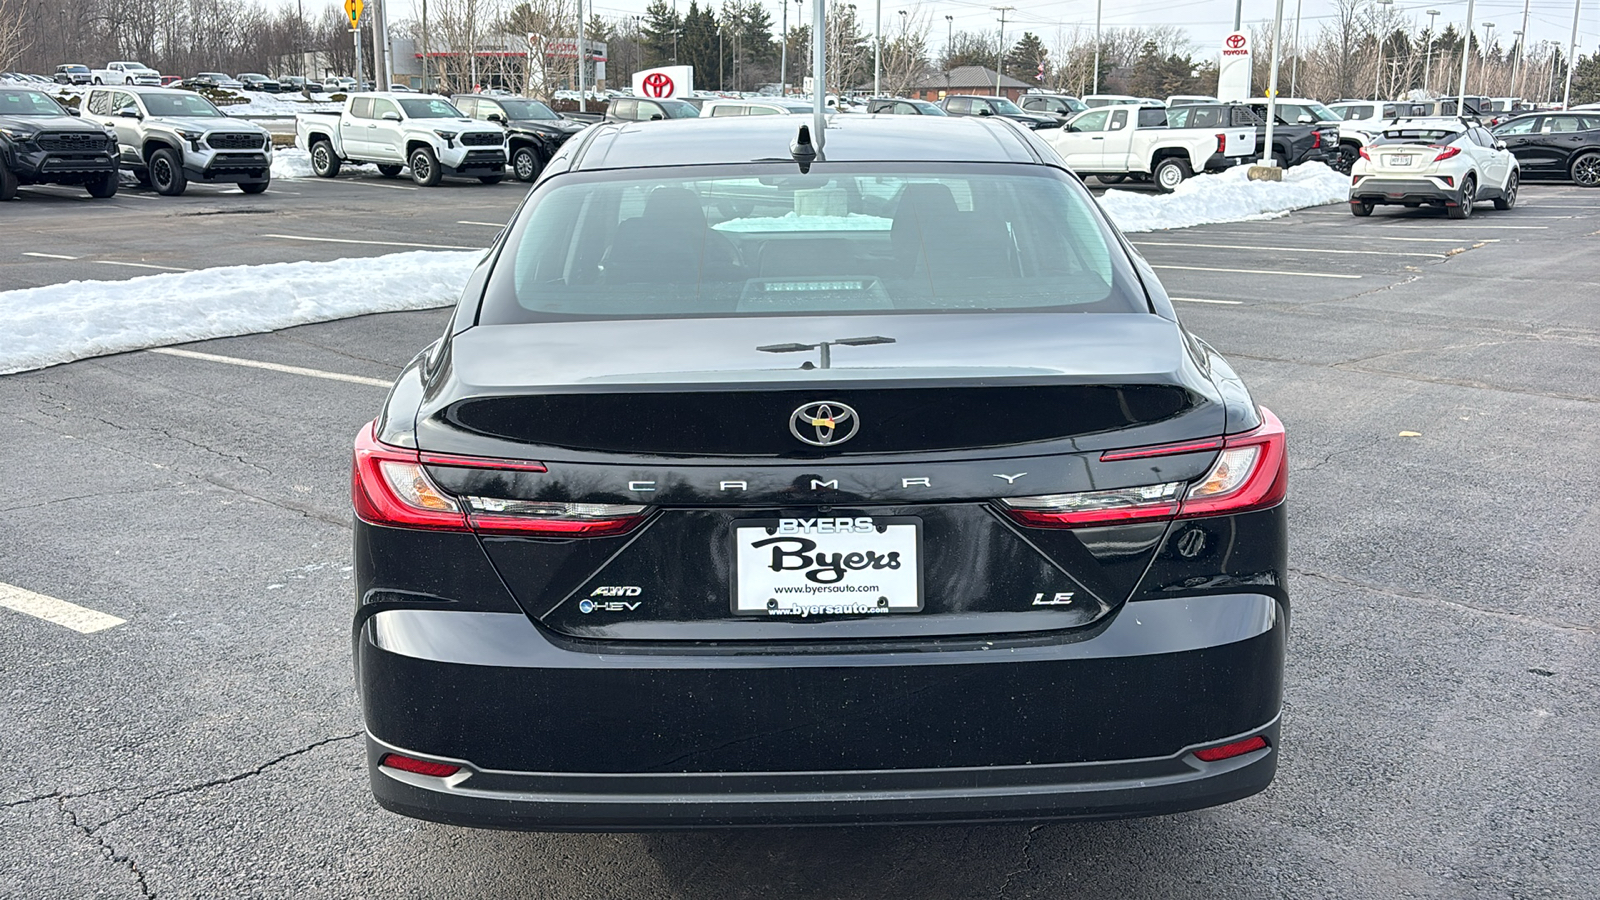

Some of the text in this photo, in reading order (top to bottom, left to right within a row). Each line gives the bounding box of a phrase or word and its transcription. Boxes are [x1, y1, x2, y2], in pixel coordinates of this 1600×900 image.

[628, 472, 1027, 491] CAMRY
[778, 517, 874, 534] BYERS
[751, 537, 901, 584] Byers
[590, 586, 642, 597] AWD
[774, 584, 879, 595] www.byersauto.com
[1031, 592, 1075, 605] LE
[594, 601, 642, 611] HEV
[768, 602, 889, 617] www.byersauto.com
